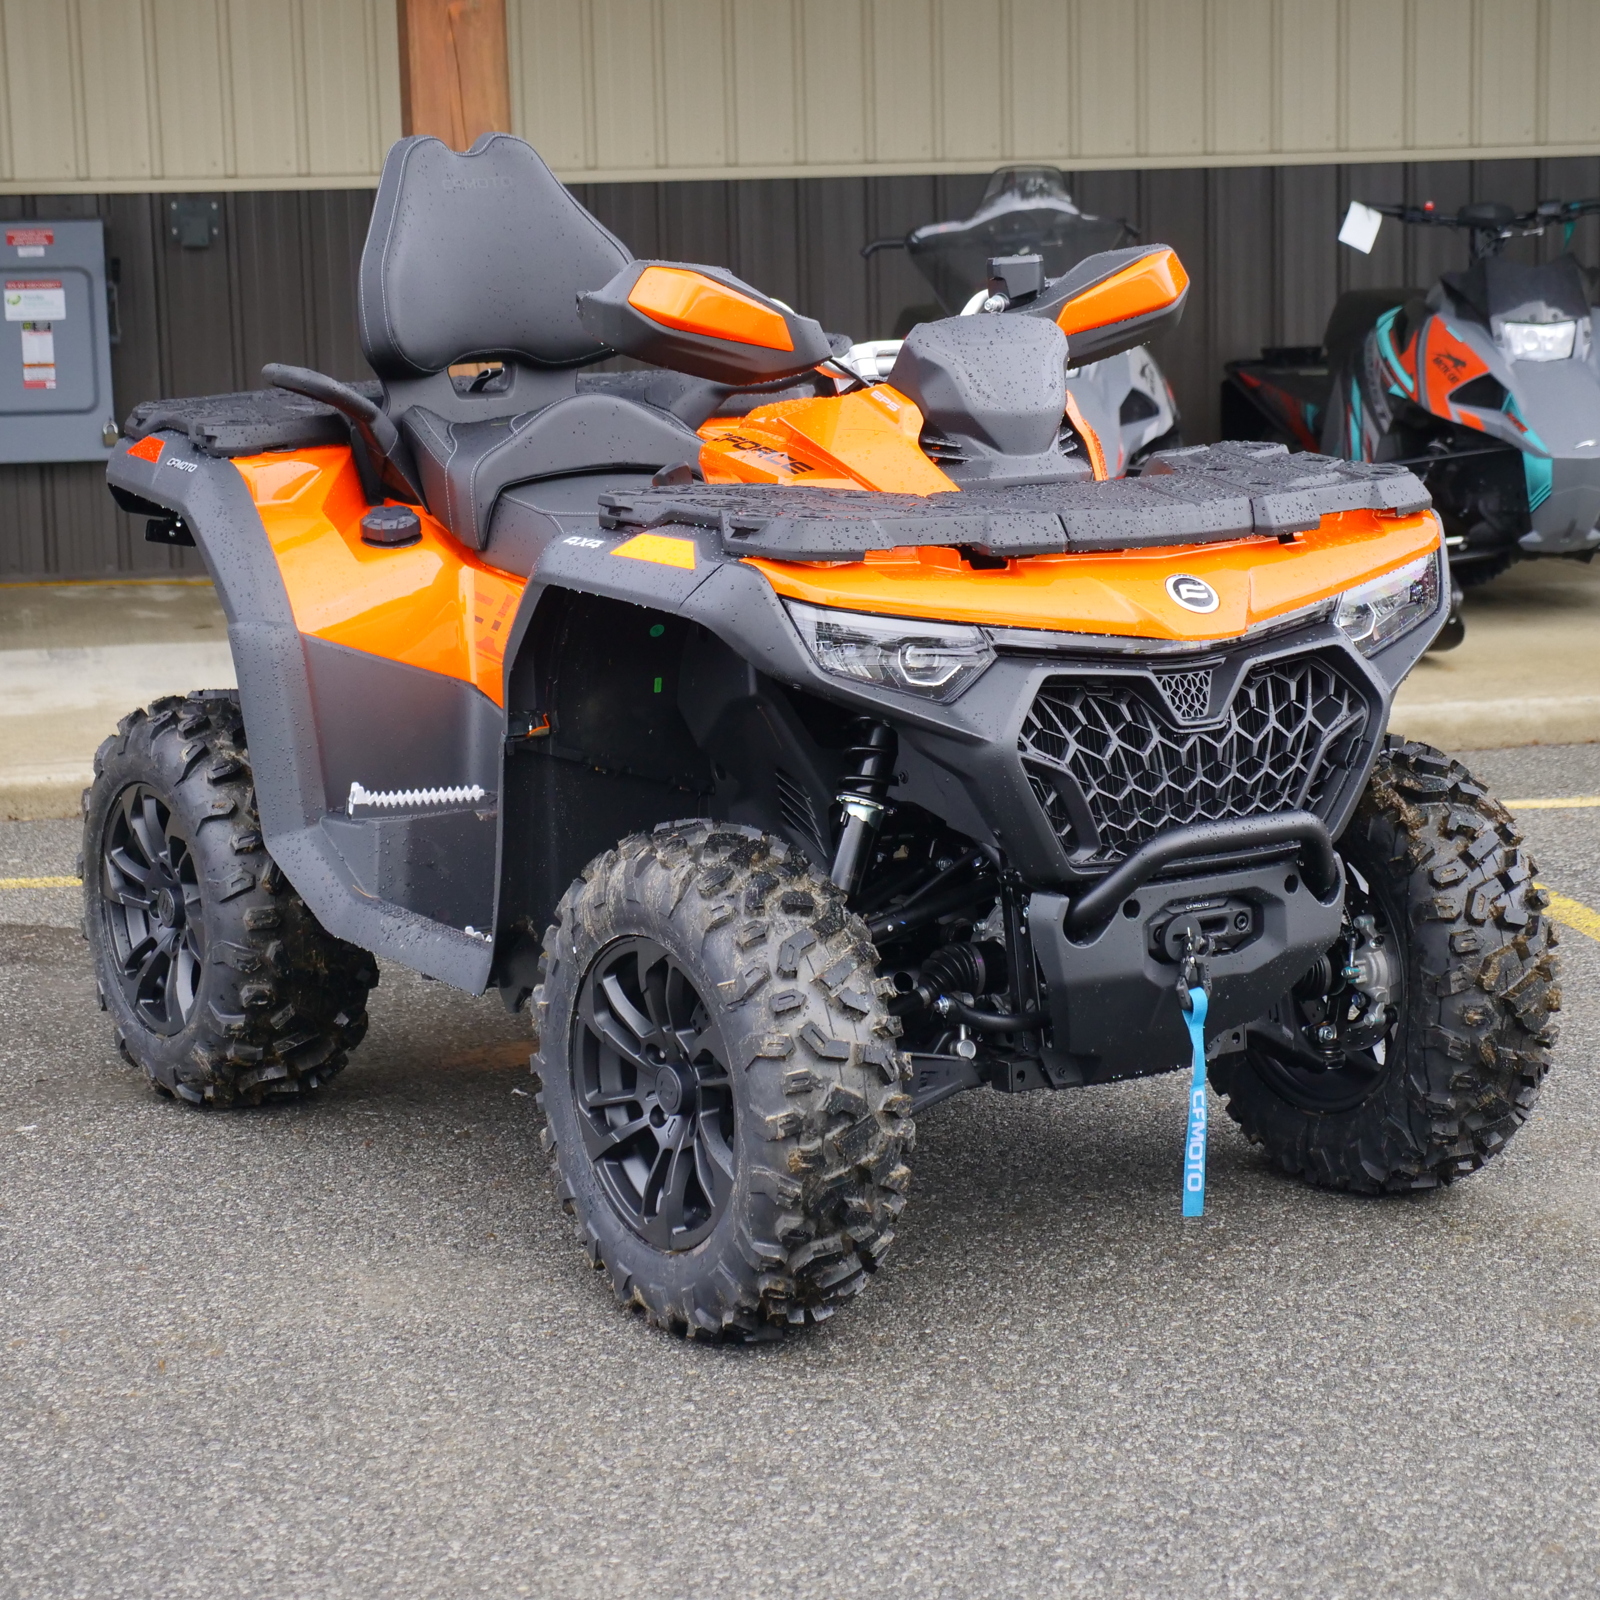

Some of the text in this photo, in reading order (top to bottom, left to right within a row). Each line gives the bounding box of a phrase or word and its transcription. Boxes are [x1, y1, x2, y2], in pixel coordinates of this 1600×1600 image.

[870, 390, 900, 411] EPS
[166, 457, 198, 472] CFMOTO
[1186, 1089, 1206, 1192] CFMOTO
